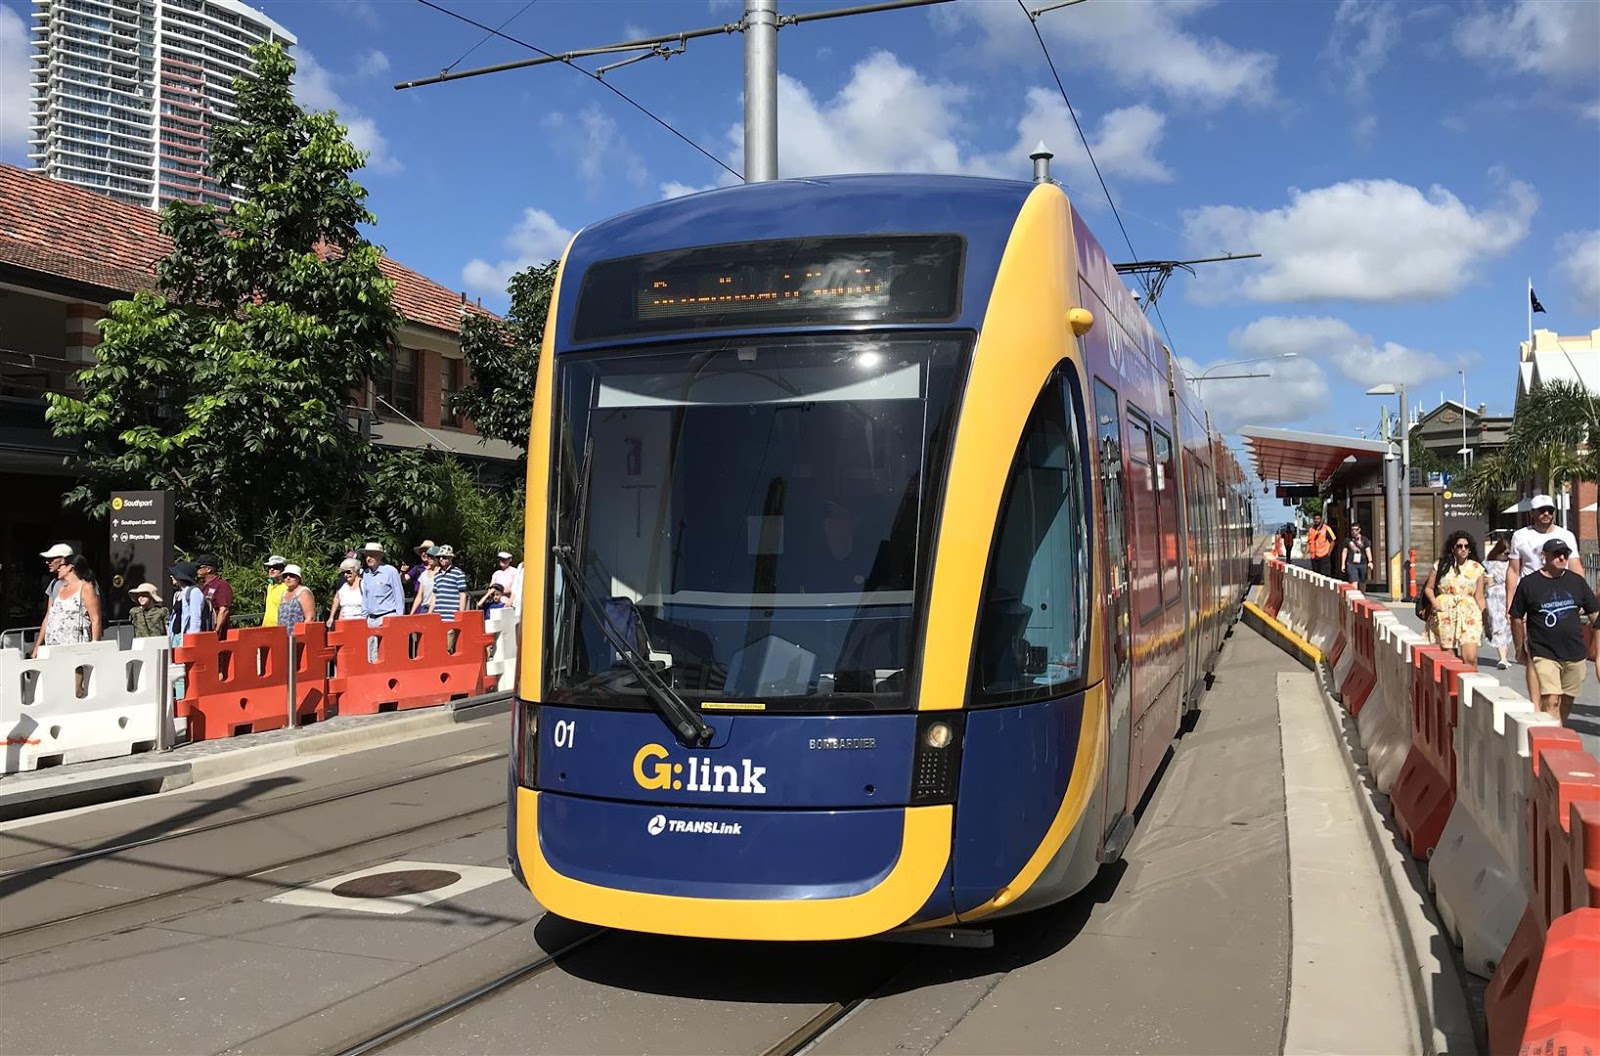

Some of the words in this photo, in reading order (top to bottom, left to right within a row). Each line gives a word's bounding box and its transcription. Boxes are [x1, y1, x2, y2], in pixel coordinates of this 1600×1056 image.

[124, 499, 153, 508] Southport
[554, 719, 575, 748] 01
[809, 738, 876, 749] BOMBARDIER
[632, 743, 767, 794] G:link
[668, 819, 742, 834] TRANSLink
